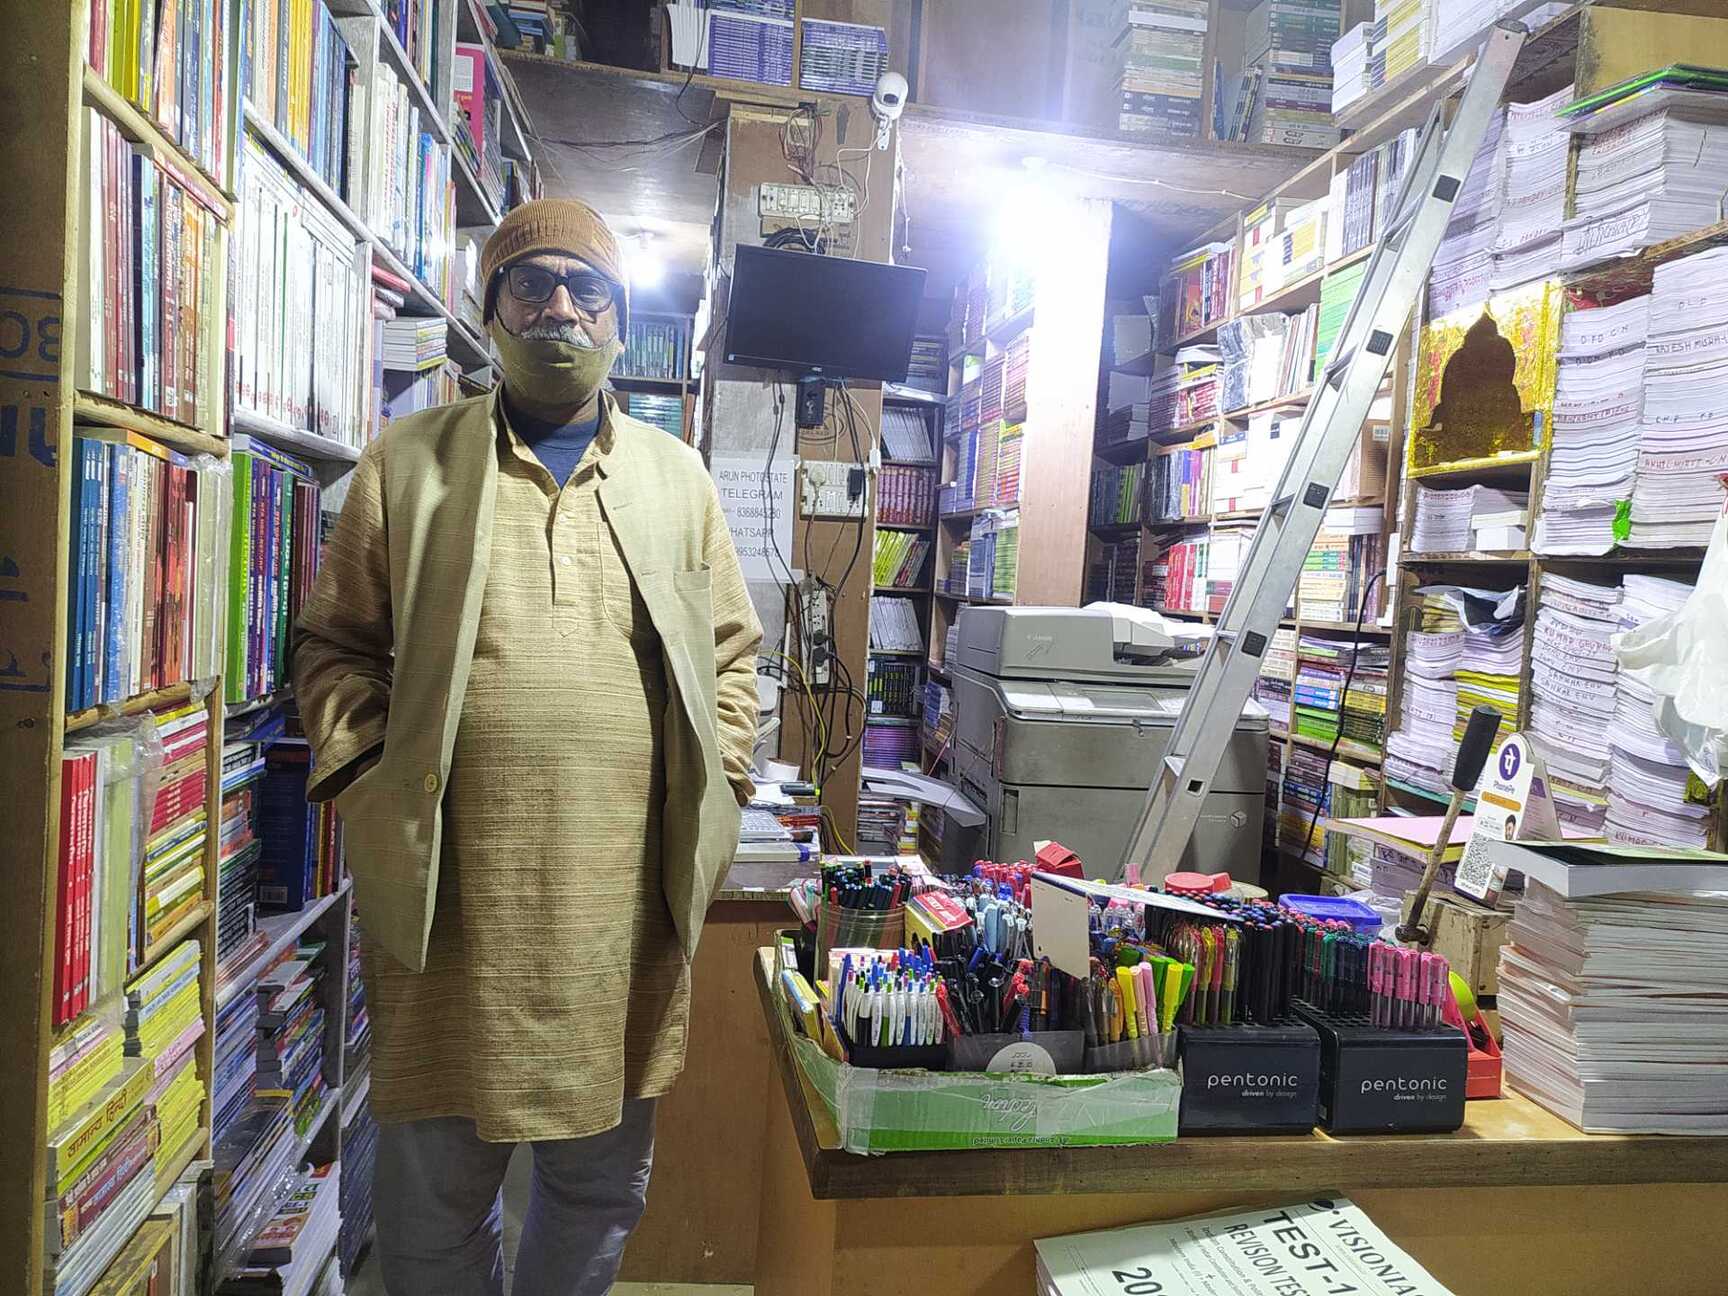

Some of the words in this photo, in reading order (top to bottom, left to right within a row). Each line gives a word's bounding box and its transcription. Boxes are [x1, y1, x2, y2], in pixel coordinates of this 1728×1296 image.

[719, 471, 740, 481] ARUN
[720, 488, 783, 500] TELEGRAM
[1207, 1072, 1298, 1090] pentonic
[1361, 1076, 1447, 1094] pentonic
[1241, 1088, 1265, 1097] driven
[1393, 1093, 1415, 1101] driven
[1223, 1223, 1288, 1277] REVISION
[1270, 1275, 1311, 1296] TES
[1263, 1210, 1359, 1295] TEST-1
[1112, 1266, 1168, 1296] 20
